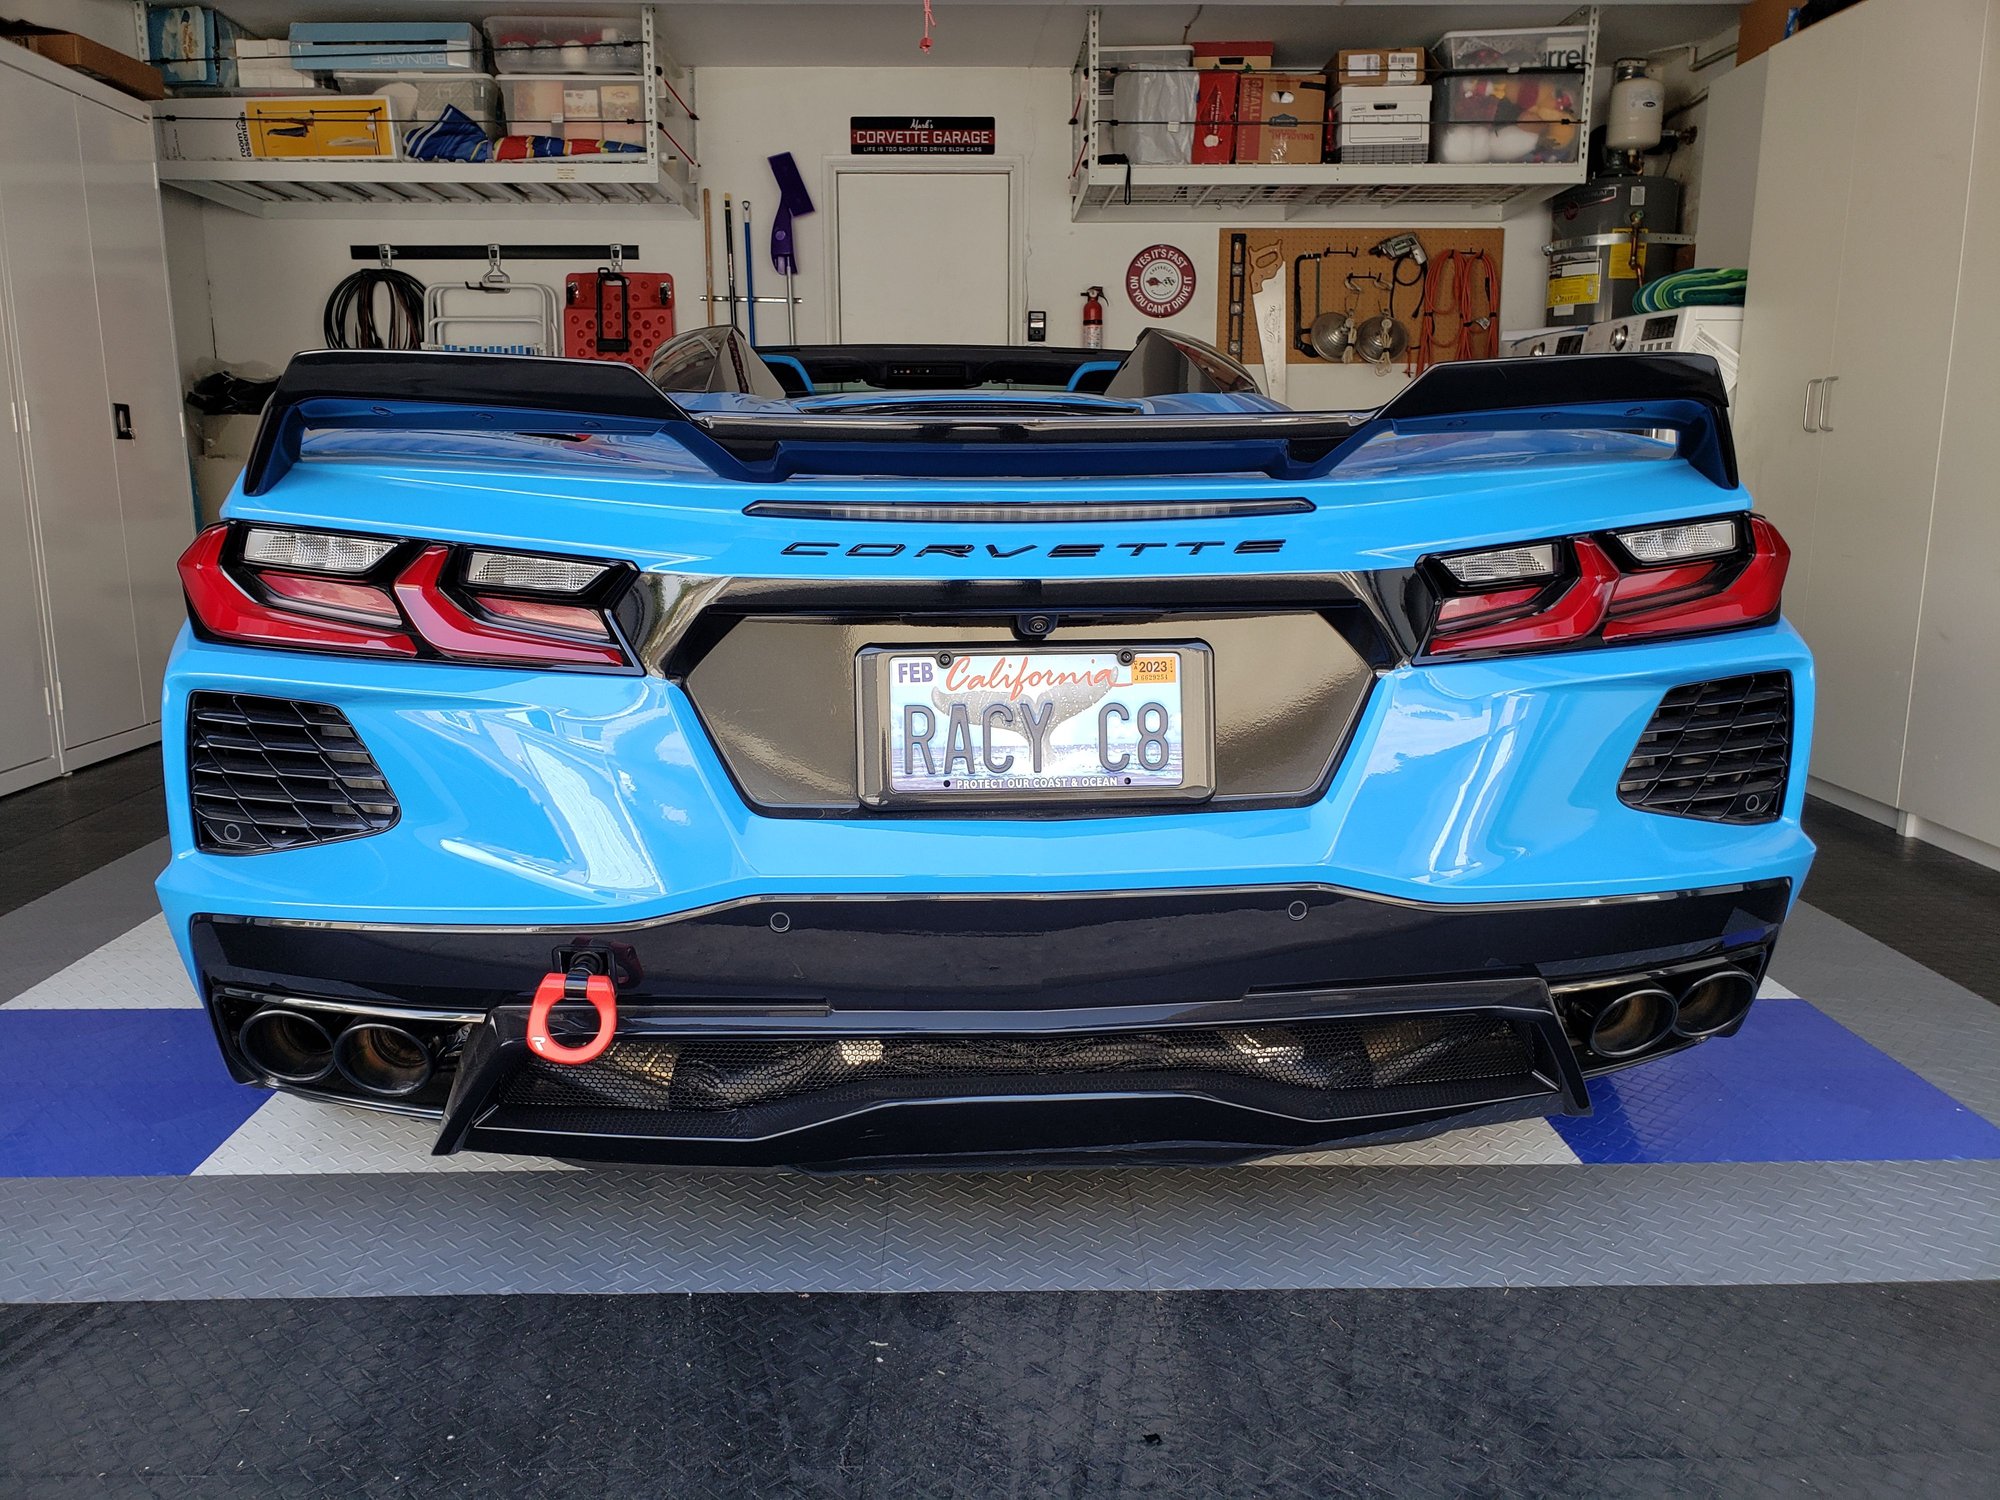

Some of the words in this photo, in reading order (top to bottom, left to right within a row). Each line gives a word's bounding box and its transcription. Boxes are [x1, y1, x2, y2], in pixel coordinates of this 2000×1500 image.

[240, 111, 252, 157] essentias
[856, 131, 929, 143] CORVETTE
[933, 131, 989, 144] GARAGE
[237, 132, 246, 157] room
[1135, 253, 1152, 268] YES
[1151, 248, 1166, 259] IT'S
[1167, 250, 1188, 268] FAST
[1130, 275, 1139, 289] NO
[1183, 275, 1193, 284] IT
[1132, 289, 1148, 307] YOU
[1171, 285, 1192, 310] DRIVE
[1146, 303, 1171, 314] CAN'T
[780, 539, 1287, 558] CORVETTE
[1138, 661, 1168, 673] 2023
[898, 662, 934, 683] FEB
[946, 655, 1133, 701] California
[903, 702, 1053, 775] RACY
[1098, 702, 1170, 773] C8
[956, 778, 1004, 789] PROTECT
[1007, 778, 1030, 788] OUR
[1030, 777, 1068, 788] COAST
[1071, 777, 1079, 787] &
[1081, 776, 1118, 787] OCEAN
